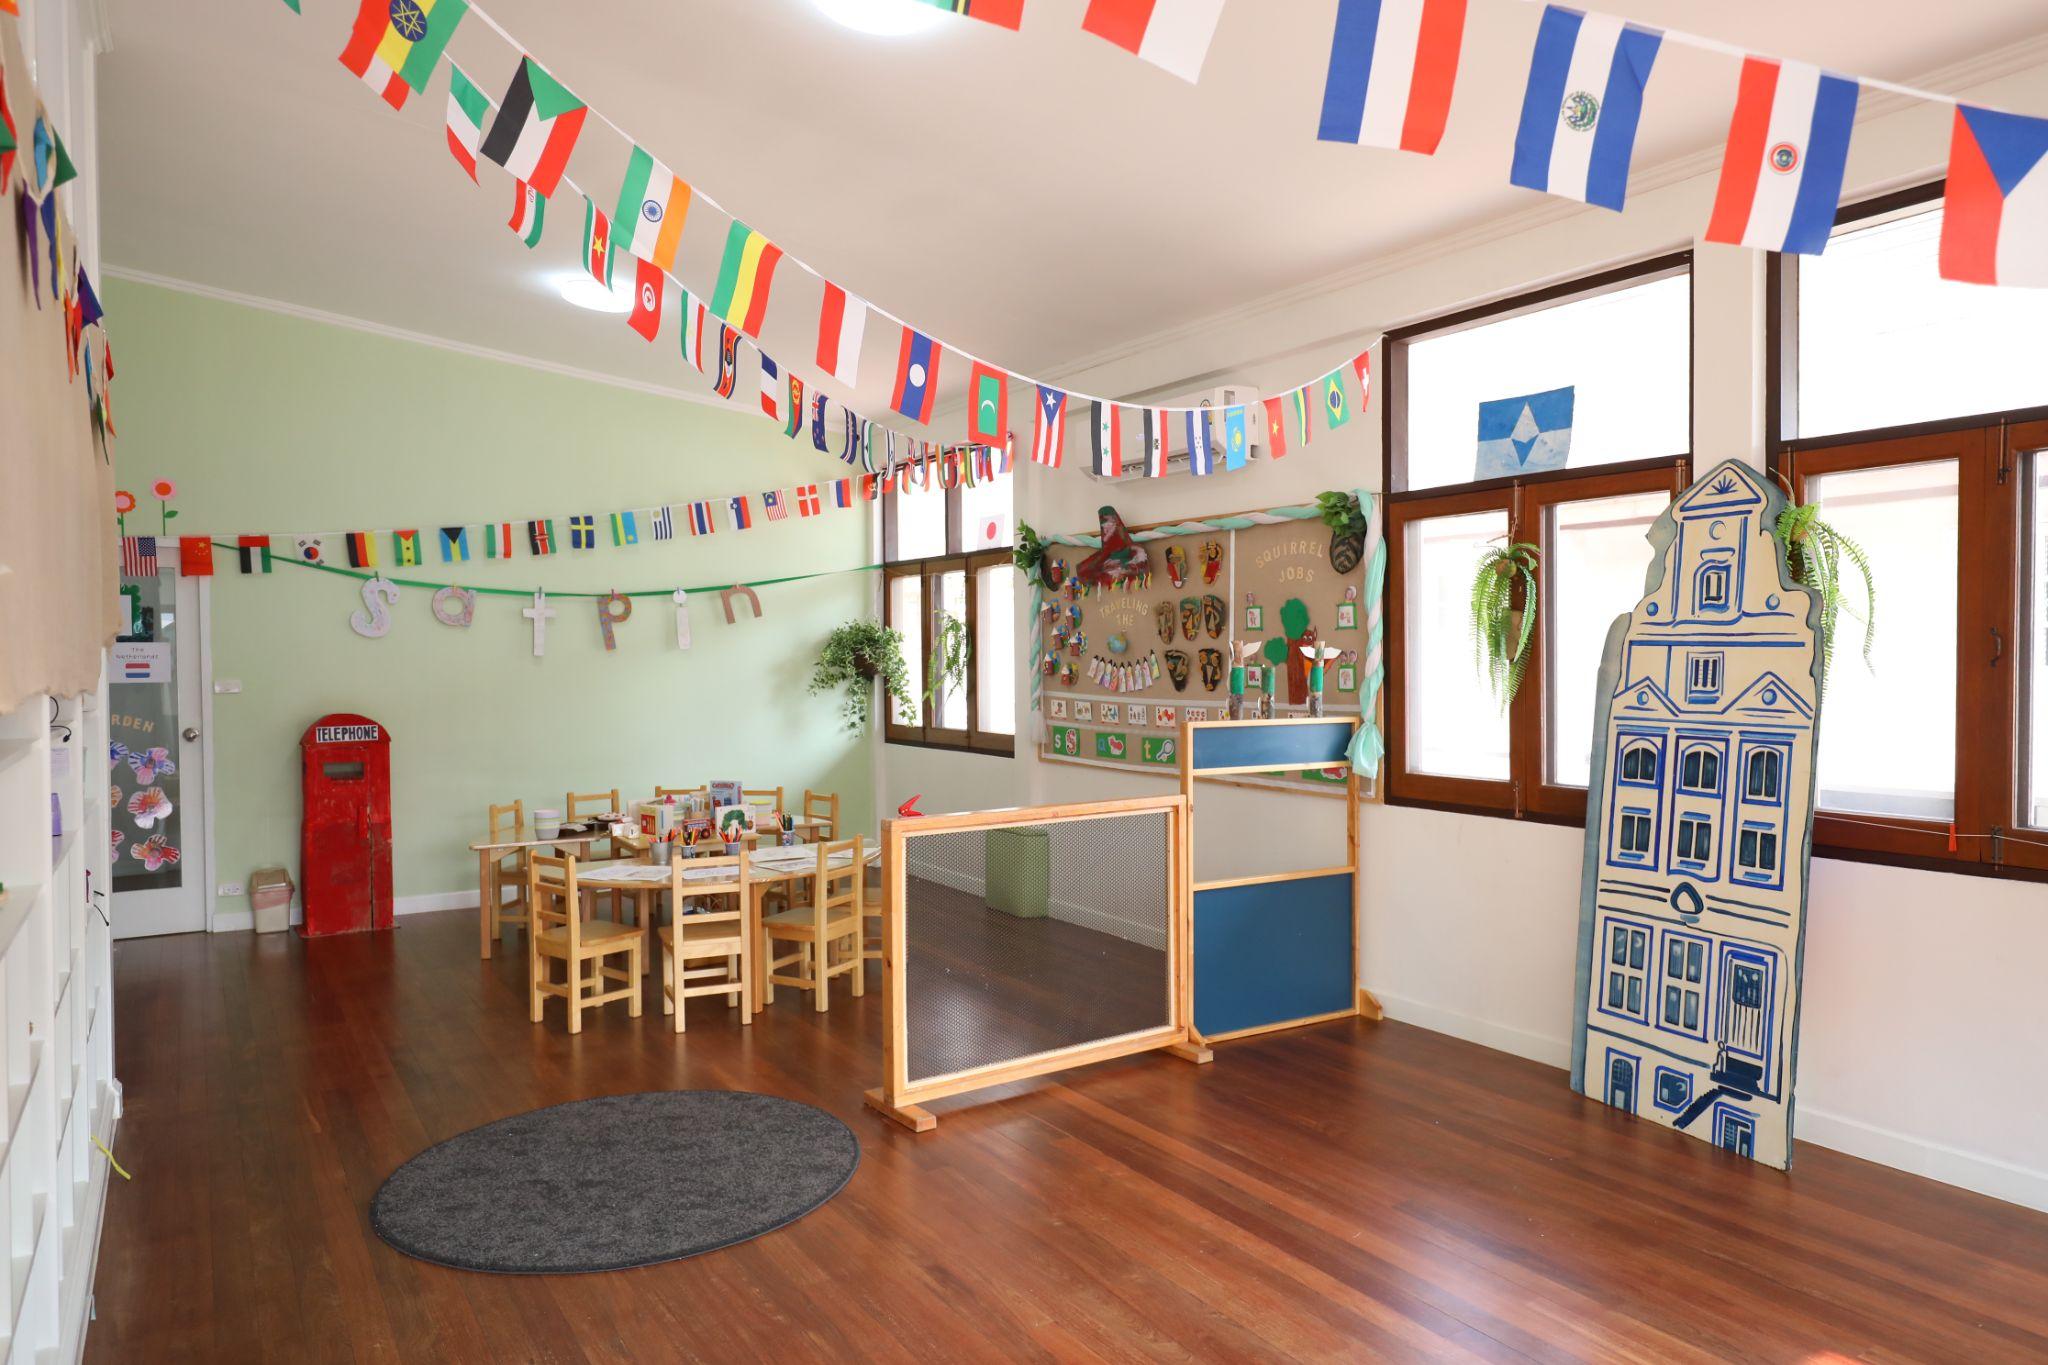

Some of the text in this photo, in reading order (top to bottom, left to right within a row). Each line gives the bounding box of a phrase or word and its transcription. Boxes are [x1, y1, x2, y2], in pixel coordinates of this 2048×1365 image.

[1256, 541, 1323, 569] SQUIRREL
[1280, 566, 1315, 582] JOBS
[1099, 597, 1149, 618] TRAVELING
[1116, 614, 1134, 626] THE
[317, 726, 378, 741] TELEPHONE
